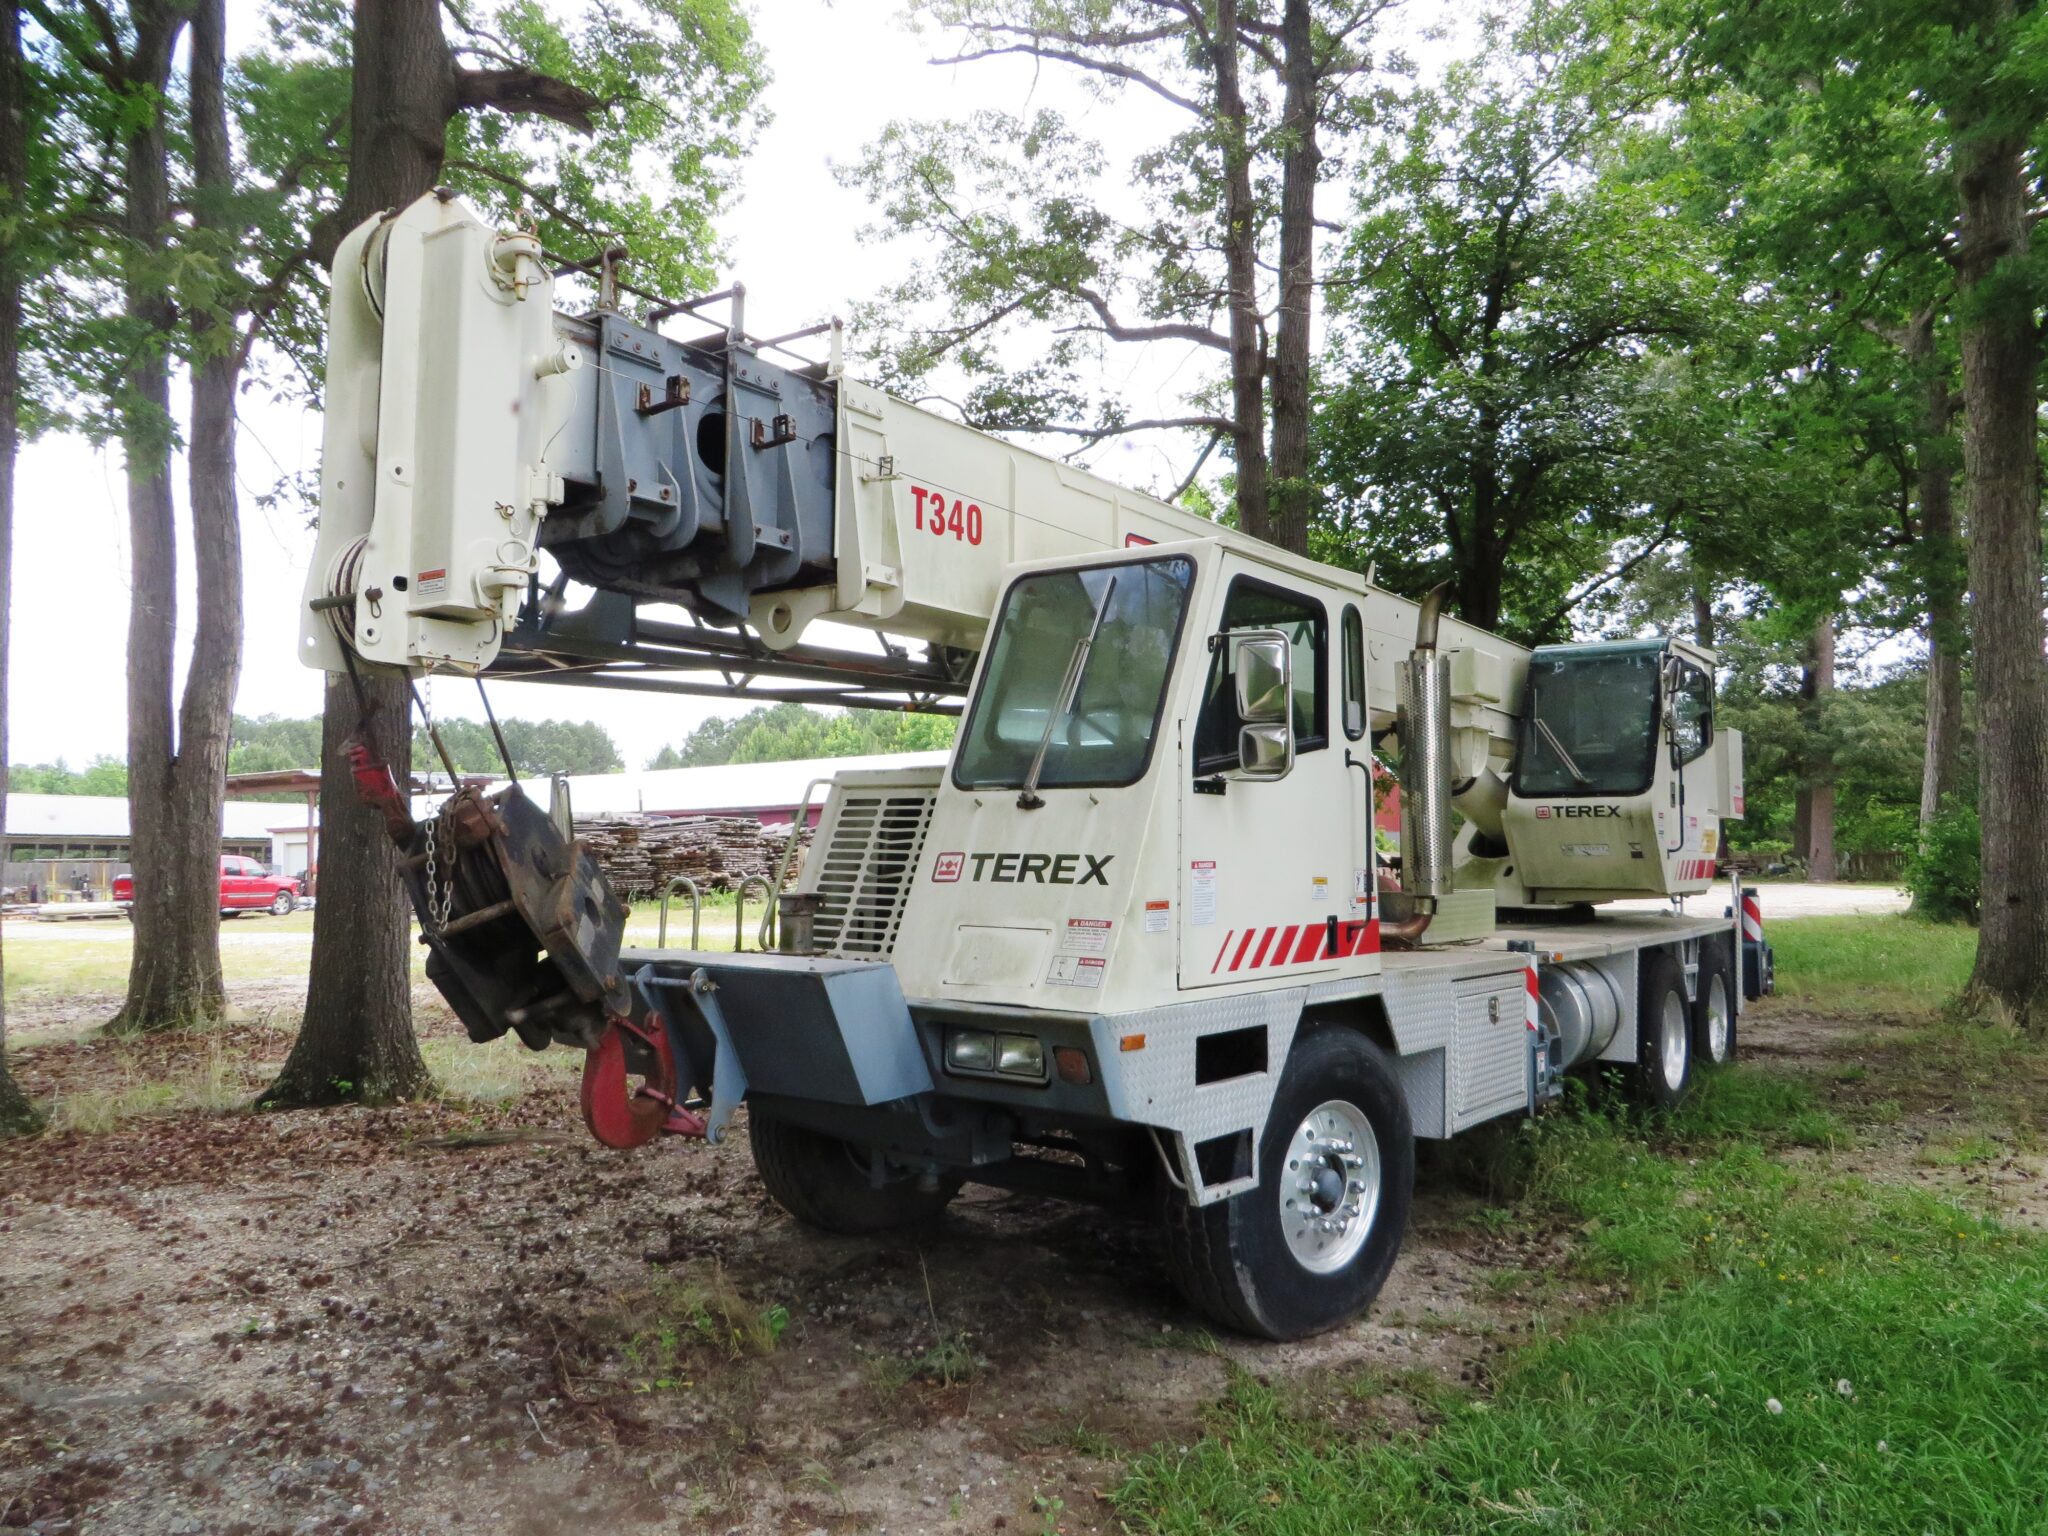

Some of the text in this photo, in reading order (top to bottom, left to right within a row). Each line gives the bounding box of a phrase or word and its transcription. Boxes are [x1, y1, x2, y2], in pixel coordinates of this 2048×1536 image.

[911, 485, 983, 546] T340
[1552, 805, 1621, 818] TEREX
[970, 853, 1115, 886] TEREX
[1079, 920, 1107, 928] DANGER
